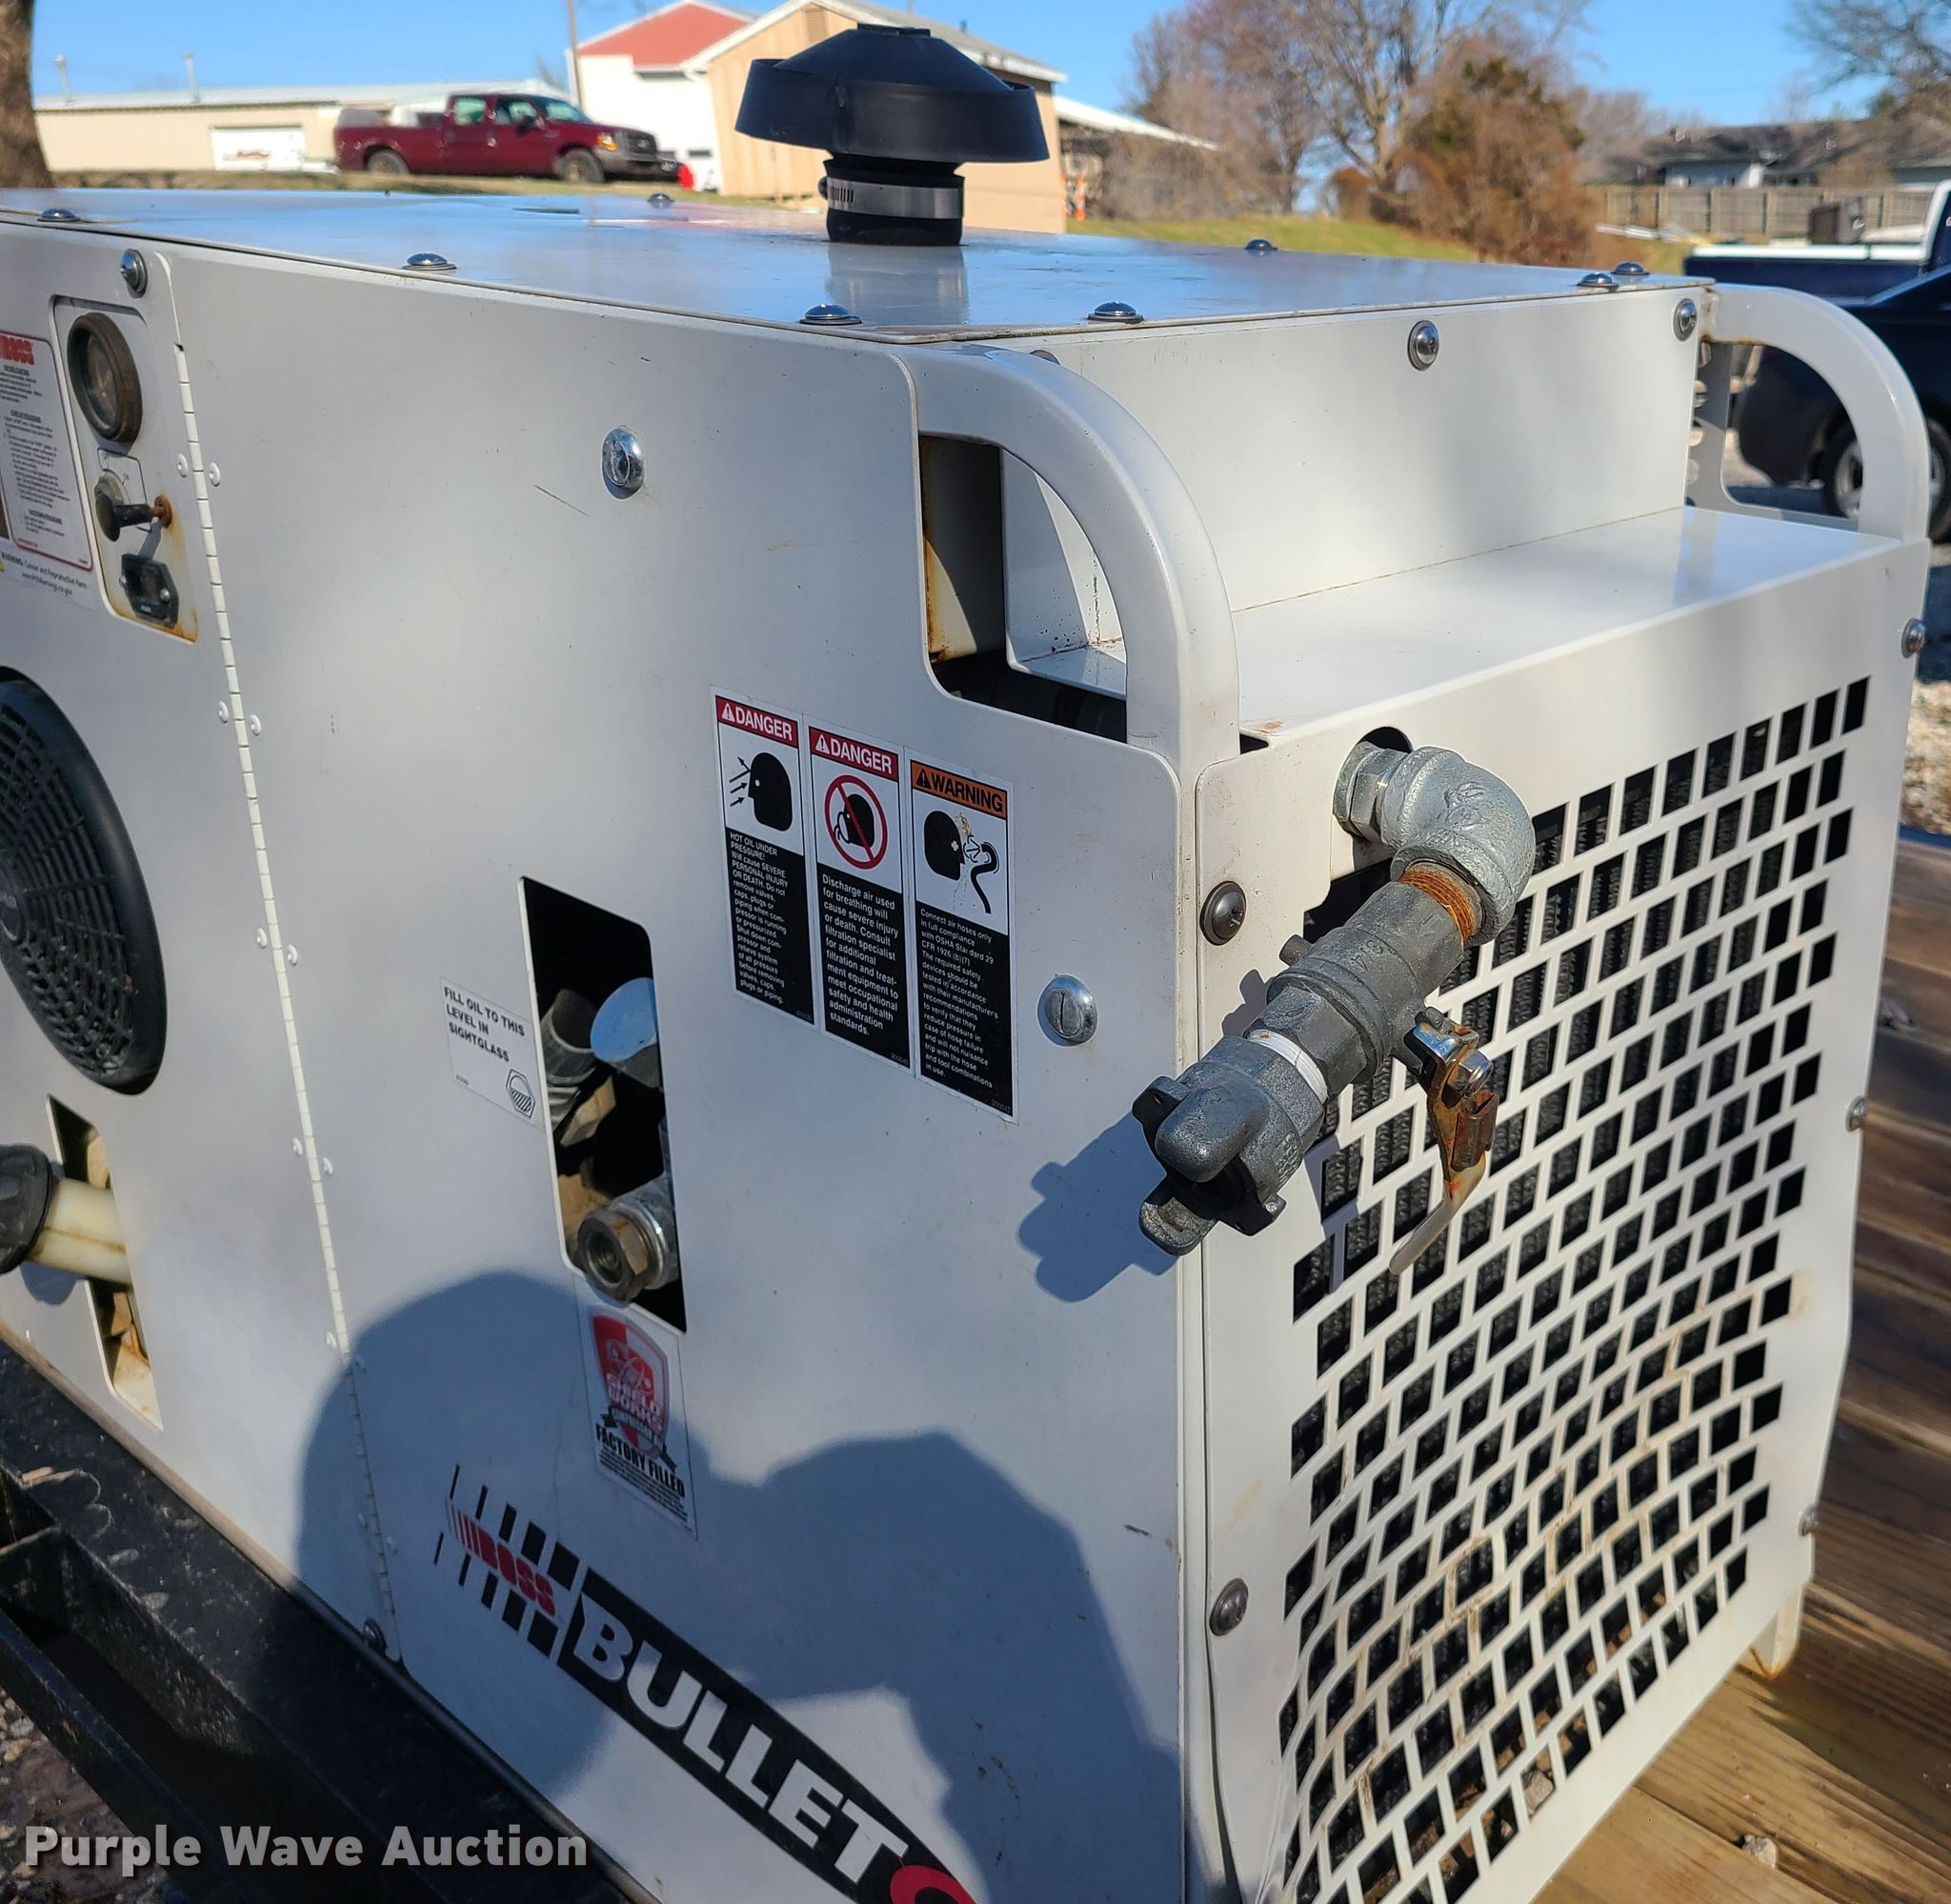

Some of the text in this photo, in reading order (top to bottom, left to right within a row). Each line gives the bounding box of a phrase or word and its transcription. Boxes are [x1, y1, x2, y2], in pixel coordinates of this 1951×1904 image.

[735, 707, 794, 741] DANGER
[831, 738, 893, 774] DANGER
[931, 772, 1003, 813] WARNING
[761, 862, 785, 878] SEVERE
[822, 874, 895, 910] Discharge air used
[823, 887, 887, 919] for breathing will
[824, 901, 898, 938] cause severe injury
[824, 913, 890, 946] or death. Consult
[920, 909, 946, 924] Connect
[957, 923, 976, 935] hoses
[977, 932, 991, 943] only
[928, 921, 937, 931] full
[939, 928, 975, 946] compliance
[825, 924, 895, 960] filtration specialist
[826, 937, 875, 964] for additional
[921, 940, 935, 951] CFR
[921, 931, 934, 940] with
[935, 935, 954, 948] OSHA
[985, 955, 993, 964] 29
[827, 950, 896, 985] filtration and treat-
[827, 964, 898, 999] ment equipment to
[922, 950, 980, 981] The required safety
[922, 962, 977, 989] devices should be
[828, 976, 897, 1011] meet occupational
[922, 972, 941, 984] tested
[950, 984, 986, 1003] accordance
[923, 983, 935, 992] with
[936, 988, 950, 997] their
[444, 987, 524, 1035] FILL OIL TO THIS
[447, 1004, 488, 1034] LEVEL IN
[829, 988, 893, 1021] safety and health
[830, 1000, 882, 1028] administration
[923, 993, 977, 1020] recommendations
[931, 1007, 948, 1019] verify
[949, 1013, 961, 1023] that
[962, 1018, 976, 1031] they
[830, 1012, 869, 1034] standards.
[924, 1013, 944, 1026] reduce
[946, 1023, 973, 1038] pressure
[924, 1023, 938, 1033] case
[947, 1032, 962, 1045] hose
[964, 1039, 983, 1052] failure
[449, 1022, 508, 1061] SIGHTGLASS
[925, 1033, 935, 1042] and
[949, 1044, 959, 1052] not
[960, 1050, 988, 1065] nuisance
[925, 1042, 976, 1071] trip with the hose
[925, 1053, 992, 1088] and tool combinations
[933, 1067, 945, 1076] use.
[595, 1424, 644, 1470] FACTORY
[648, 1457, 685, 1496] FILLED
[572, 1593, 909, 1883] BULLET
